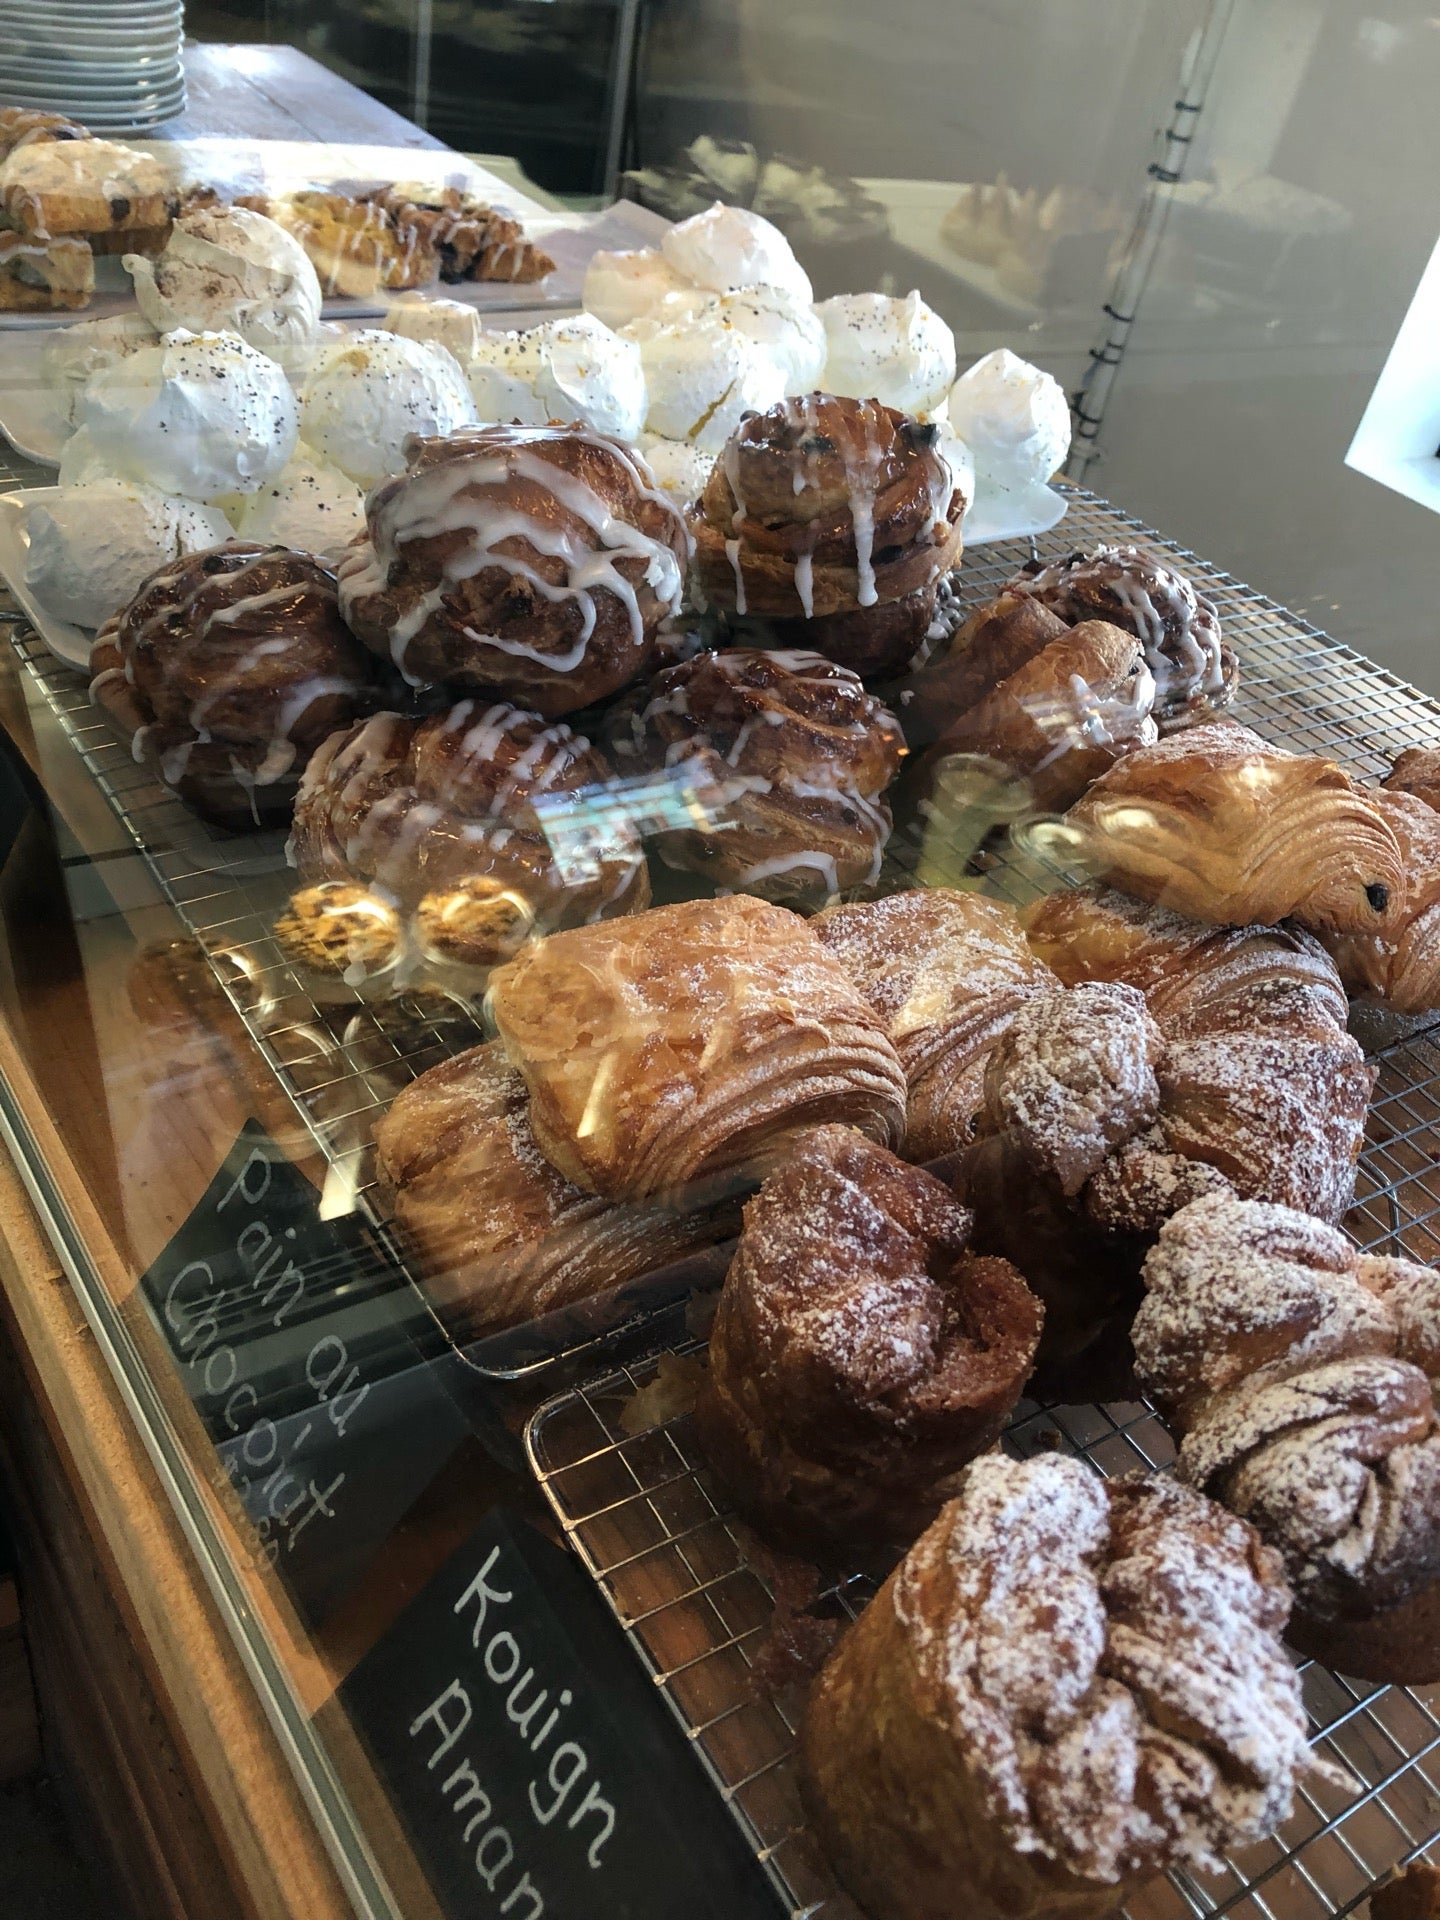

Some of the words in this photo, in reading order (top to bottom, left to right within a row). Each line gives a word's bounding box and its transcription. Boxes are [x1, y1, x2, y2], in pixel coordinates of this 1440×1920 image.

[165, 1260, 346, 1552] Chocolat
[217, 1147, 305, 1327] Pain
[305, 1335, 370, 1437] au
[408, 1677, 545, 1920] Aman
[453, 1545, 616, 1869] Kouign
